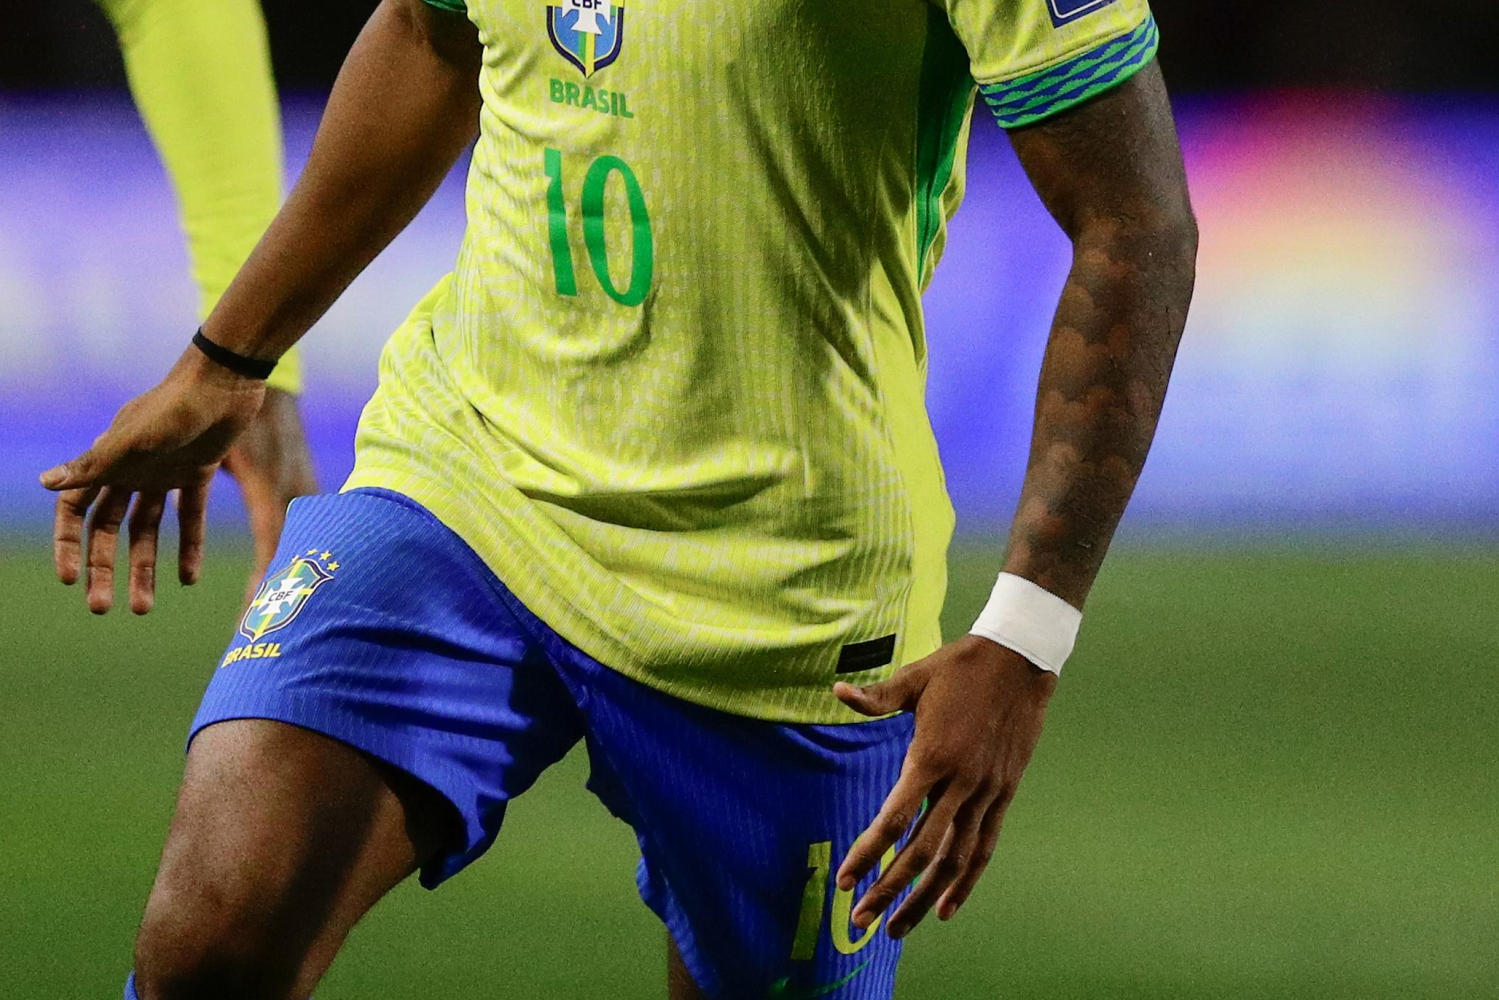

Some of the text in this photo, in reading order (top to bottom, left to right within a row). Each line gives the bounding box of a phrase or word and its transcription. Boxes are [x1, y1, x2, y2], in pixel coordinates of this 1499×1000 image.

[550, 78, 634, 119] BRASIL
[544, 147, 654, 307] 10
[268, 591, 293, 602] CBF
[220, 643, 282, 668] BRASIL
